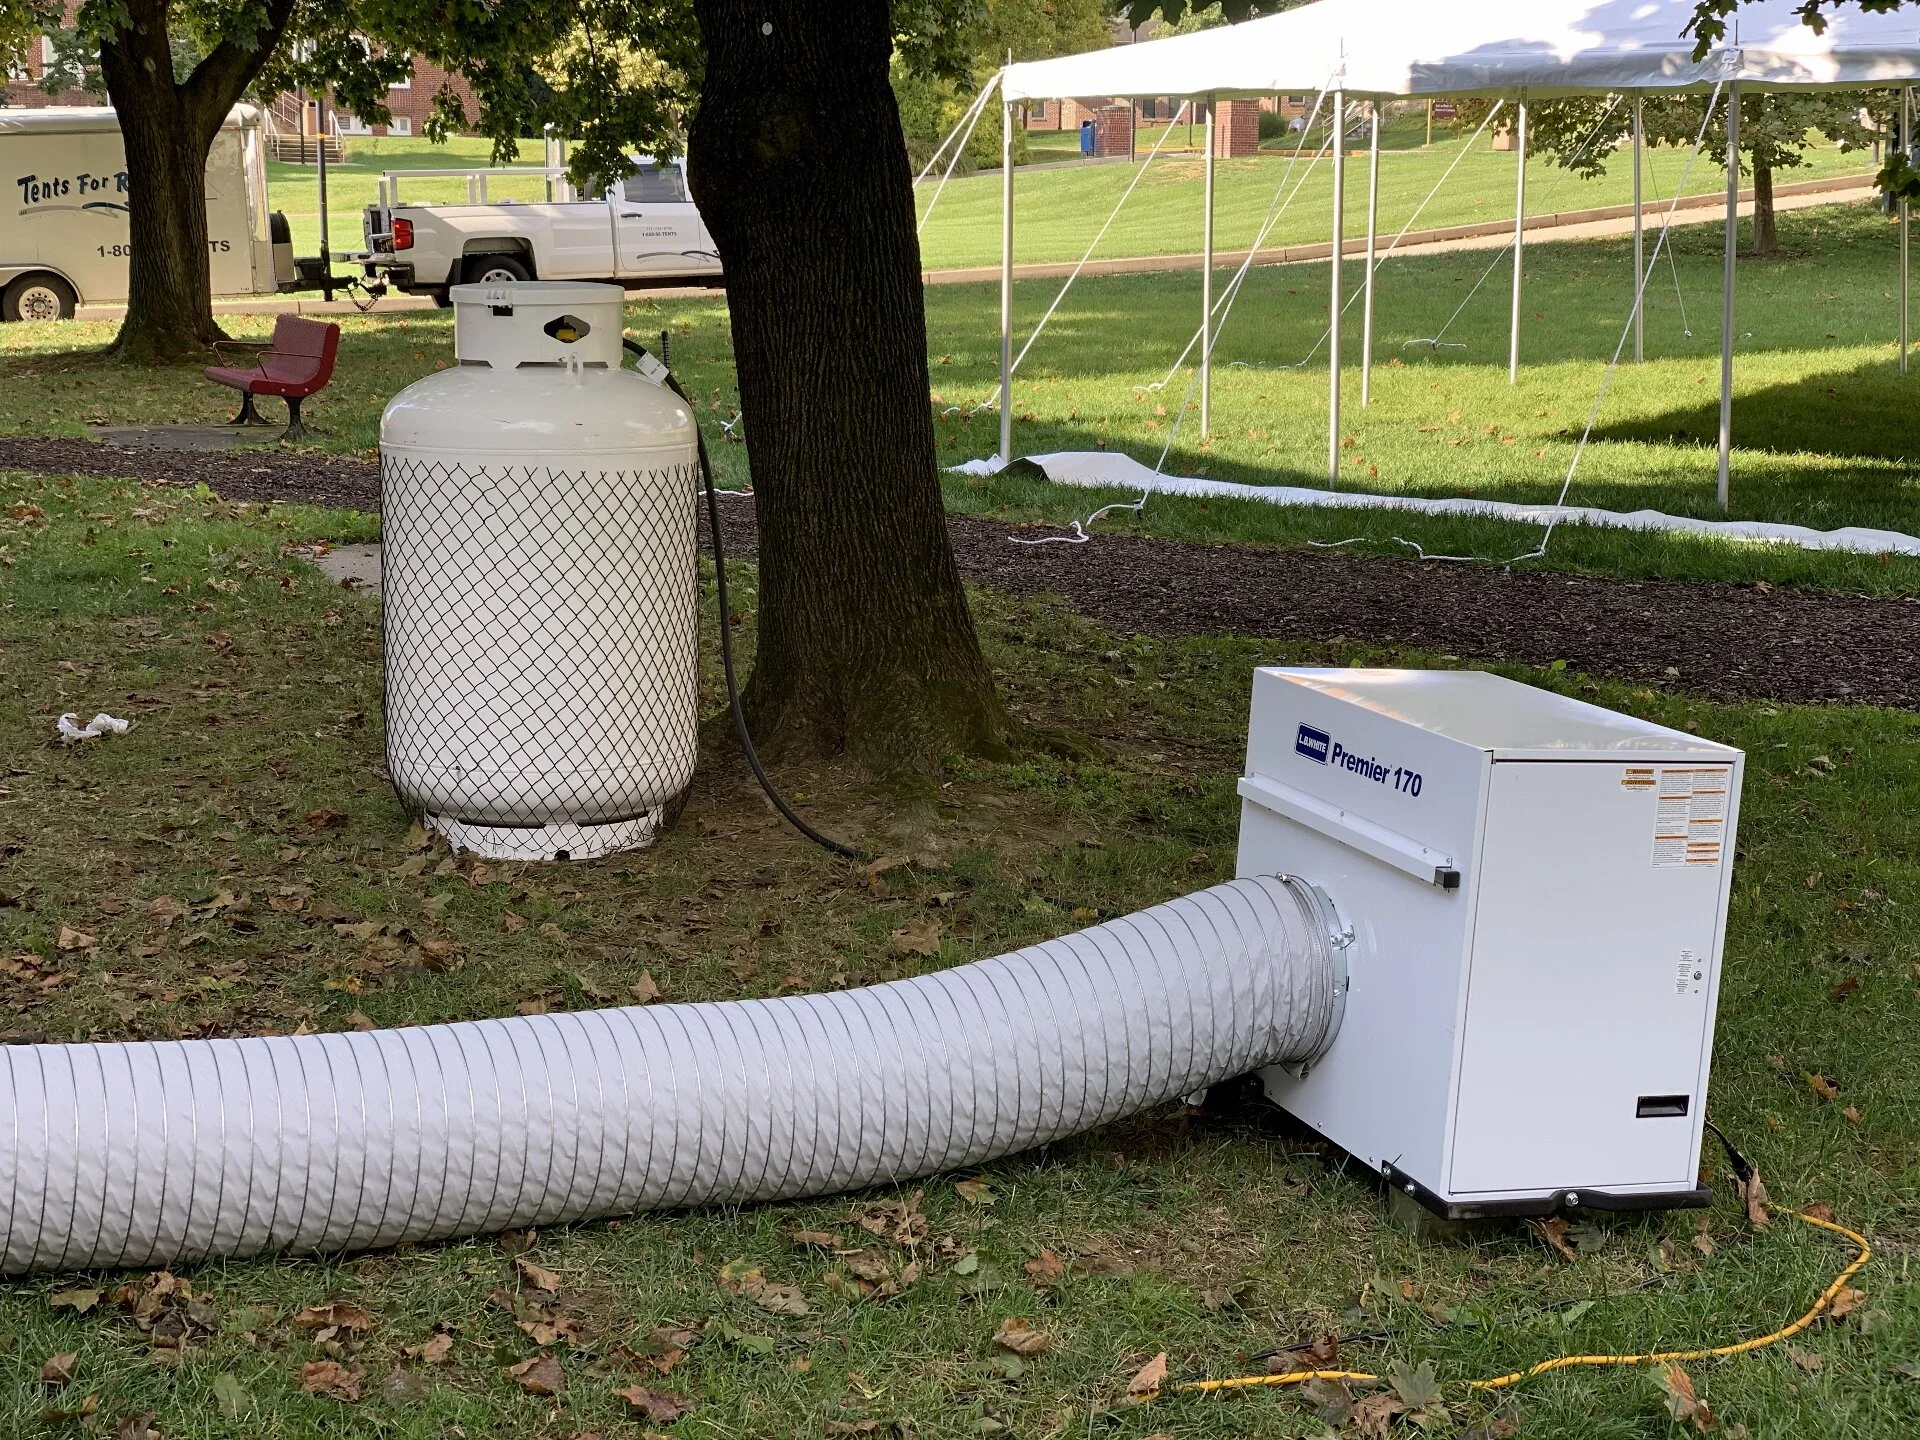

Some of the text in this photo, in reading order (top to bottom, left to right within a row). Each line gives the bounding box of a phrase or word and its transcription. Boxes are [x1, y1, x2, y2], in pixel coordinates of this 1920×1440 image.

[17, 174, 70, 205] Tents
[77, 173, 109, 195] For
[1331, 742, 1423, 797] Premier 170
